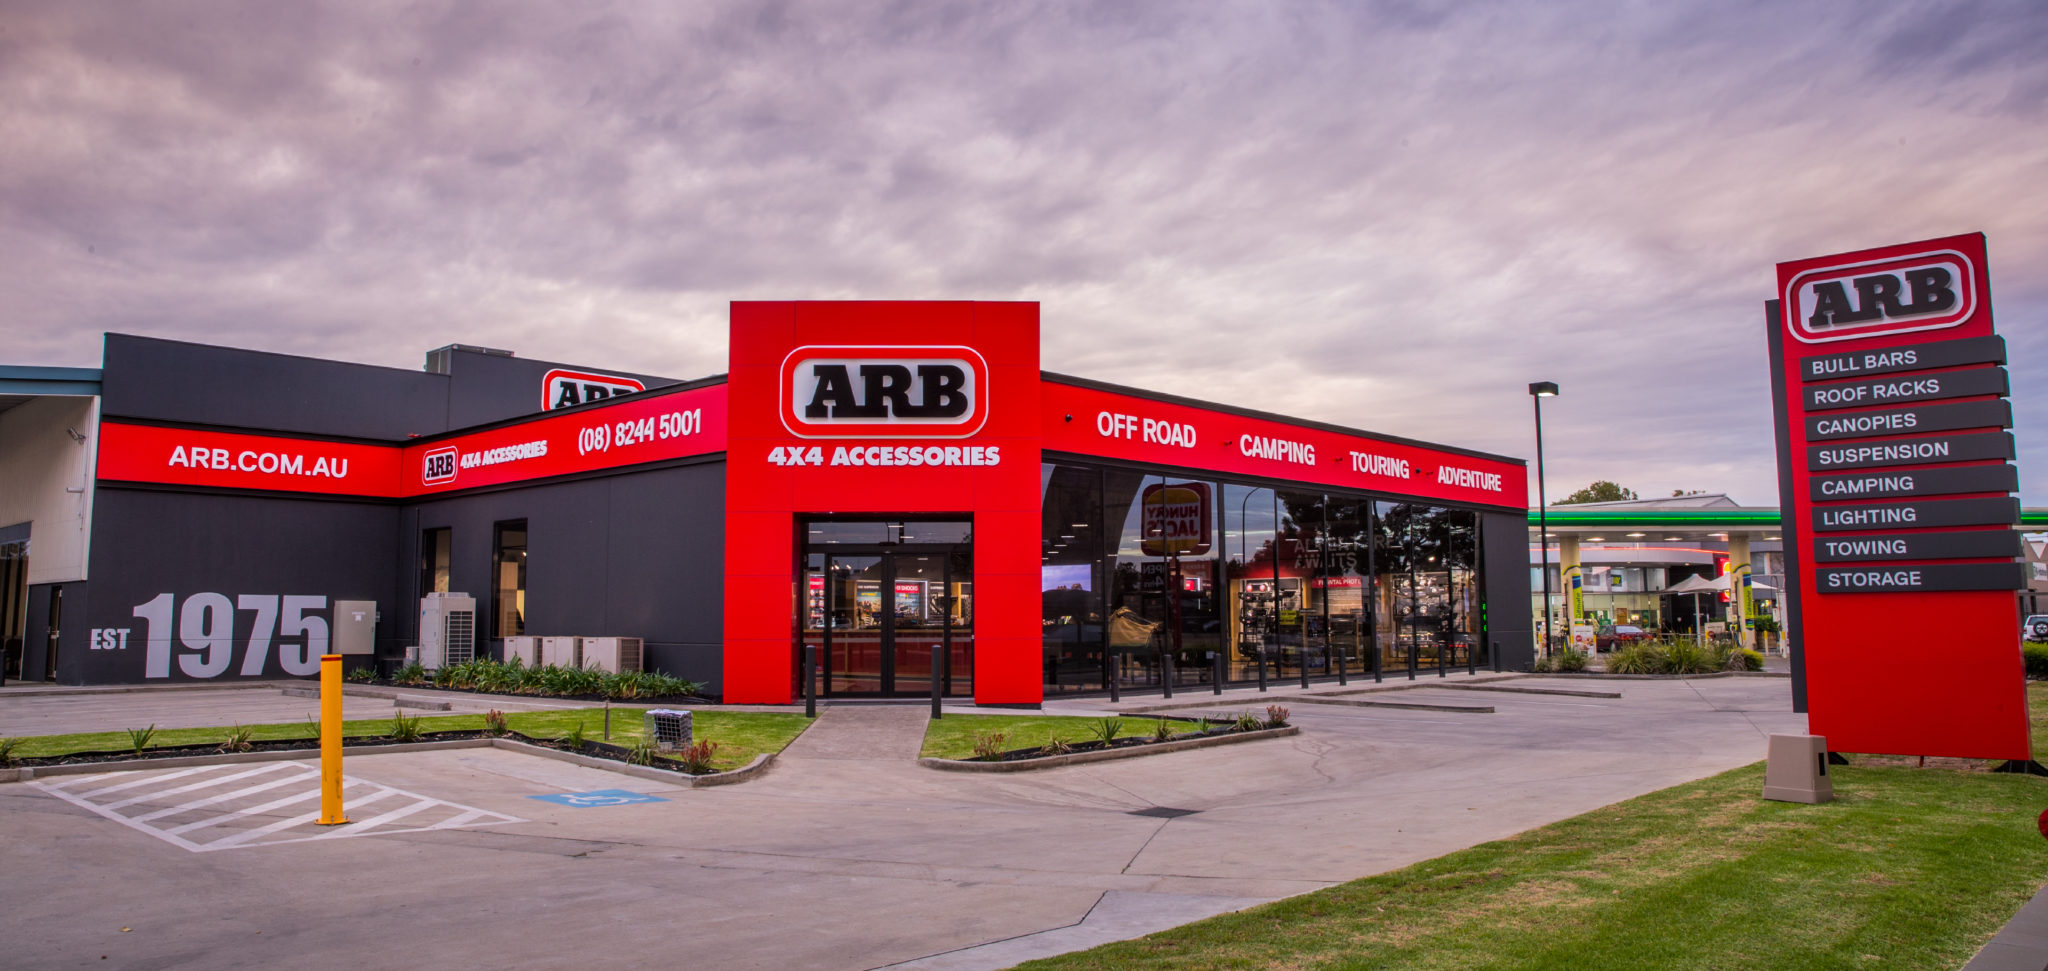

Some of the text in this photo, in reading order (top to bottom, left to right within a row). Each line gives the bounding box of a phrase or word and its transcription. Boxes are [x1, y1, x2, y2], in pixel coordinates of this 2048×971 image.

[1808, 266, 1956, 328] ARB
[1812, 350, 1918, 375] BULL BARS
[805, 364, 968, 418] ARB
[1814, 379, 1940, 405] ROOF RACKS
[578, 408, 701, 456] (08) 8244 5001
[1816, 412, 1917, 435] CANOPIES
[168, 445, 348, 478] ARB.COM.AU
[460, 440, 548, 469] 4X4 ACCESSORIES
[767, 446, 1001, 467] 4X4 ACCESSORIES
[1097, 411, 1502, 493] OFF ROAD CAMPING TOURING ADVENTURE
[1819, 441, 1949, 465] SUSPENSION
[426, 454, 454, 479] ARB
[1821, 476, 1914, 495] CAMPING
[1823, 507, 1917, 526] LIGHTING
[1826, 539, 1907, 557] TOWING
[1828, 571, 1922, 587] STORAGE
[90, 591, 329, 679] EST 1975
